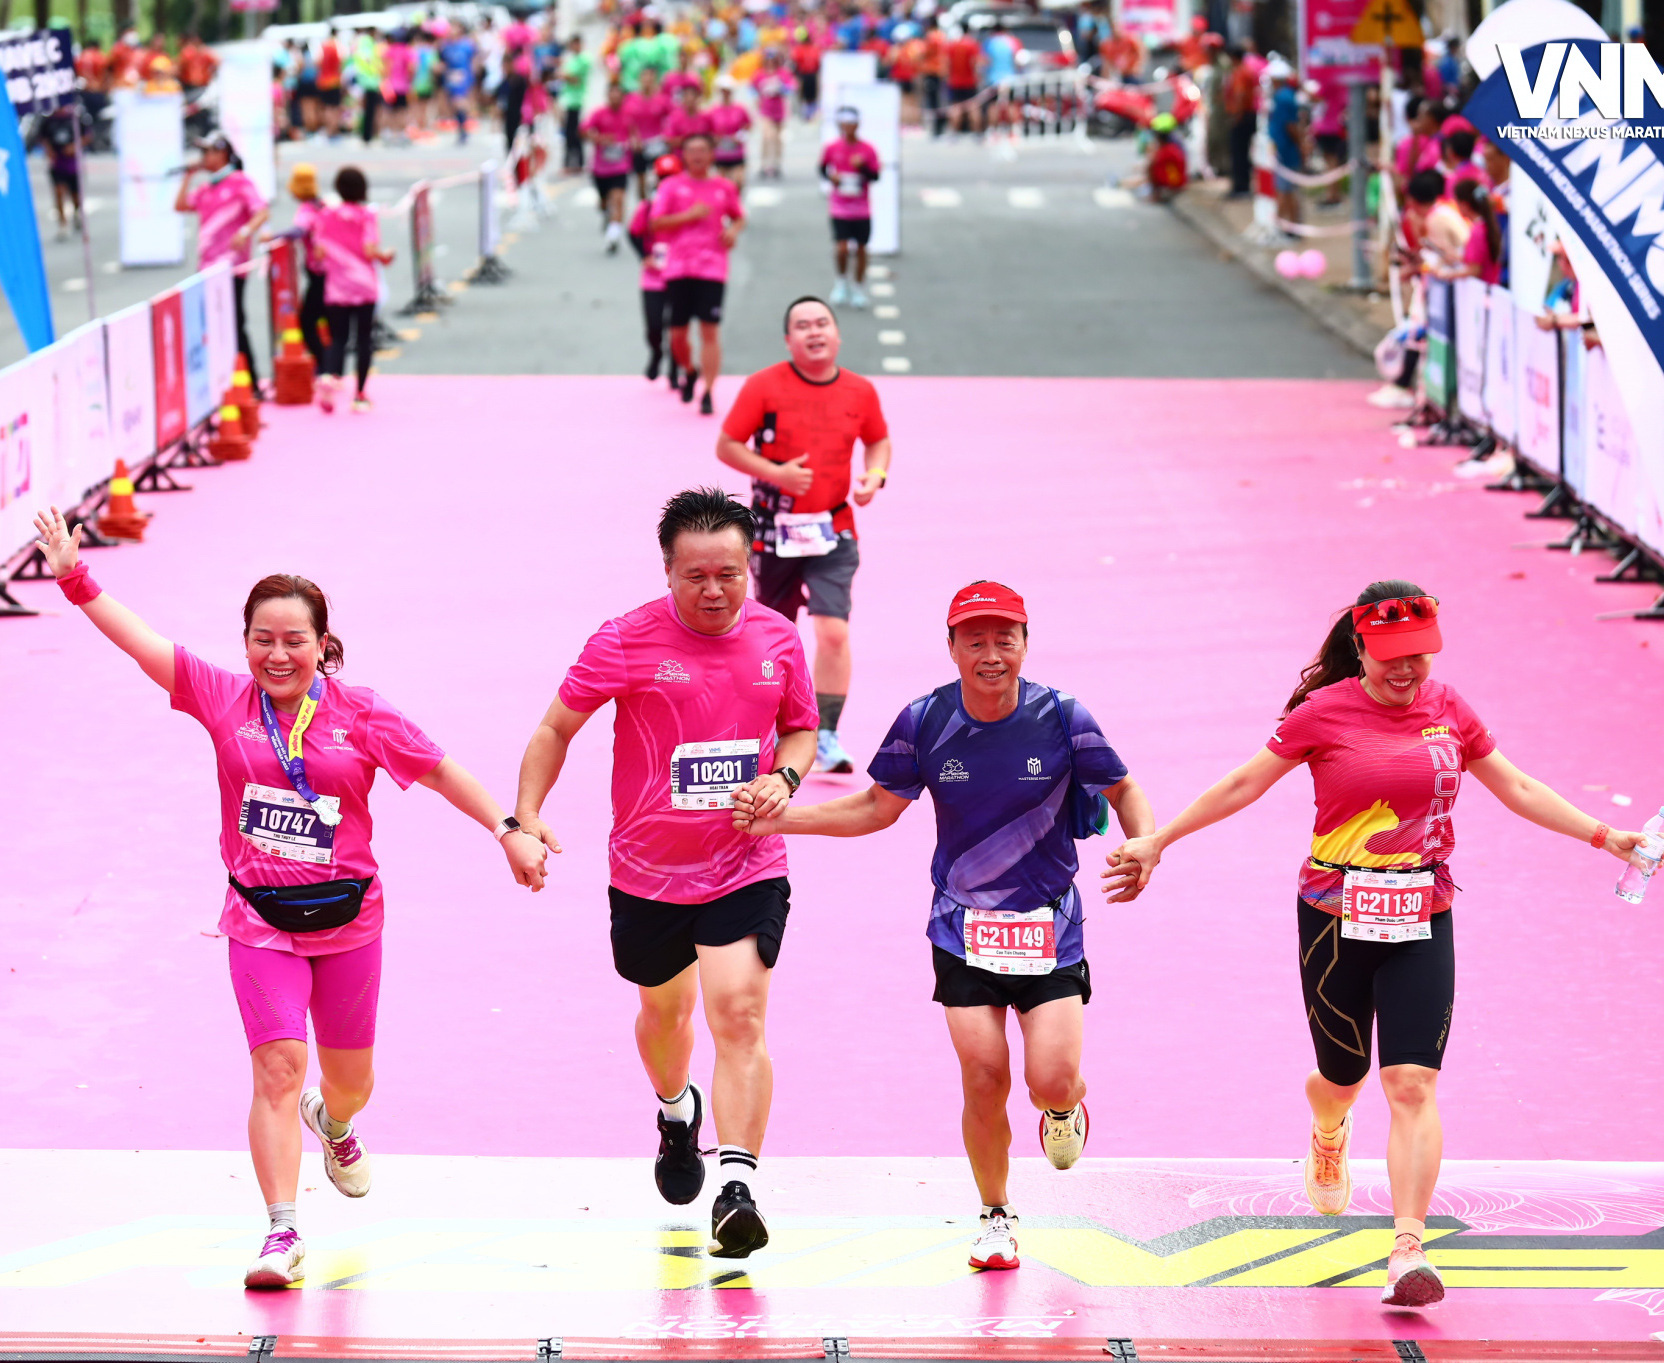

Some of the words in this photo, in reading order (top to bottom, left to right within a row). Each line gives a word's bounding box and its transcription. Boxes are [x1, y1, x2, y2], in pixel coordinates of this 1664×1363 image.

[1422, 726, 1450, 736] PMH
[690, 760, 742, 783] 10201
[260, 807, 316, 835] 10747
[1344, 888, 1352, 912] 21KM
[1356, 891, 1422, 914] C21130
[976, 925, 1044, 947] C21149
[620, 1320, 1064, 1330] MARATHON
